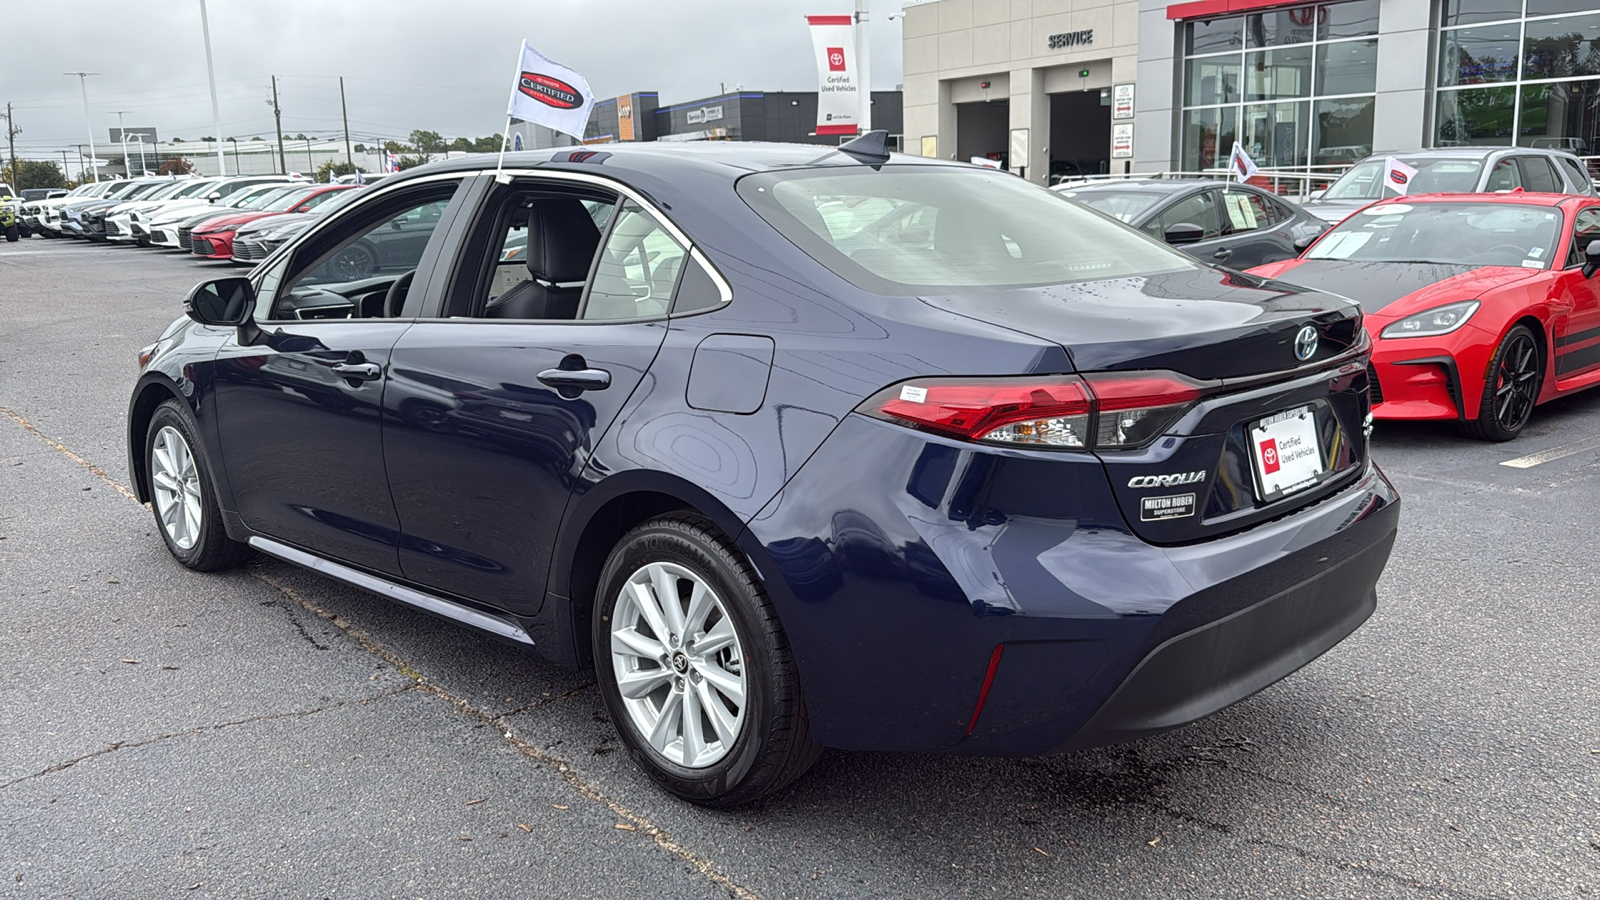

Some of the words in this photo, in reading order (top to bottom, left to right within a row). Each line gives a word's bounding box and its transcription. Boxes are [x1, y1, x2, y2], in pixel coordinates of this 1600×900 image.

[1048, 29, 1093, 49] SERVICE
[521, 78, 575, 102] CERTIFIED
[1279, 436, 1302, 450] Certified
[1281, 452, 1295, 464] Used
[1295, 446, 1315, 460] Vehicles
[1127, 470, 1206, 488] COROLLA
[1145, 498, 1171, 509] MILTON
[1172, 495, 1193, 507] RUBEN
[1154, 507, 1186, 515] SUPERSTORE
[643, 536, 712, 570] YOKOHAMA
